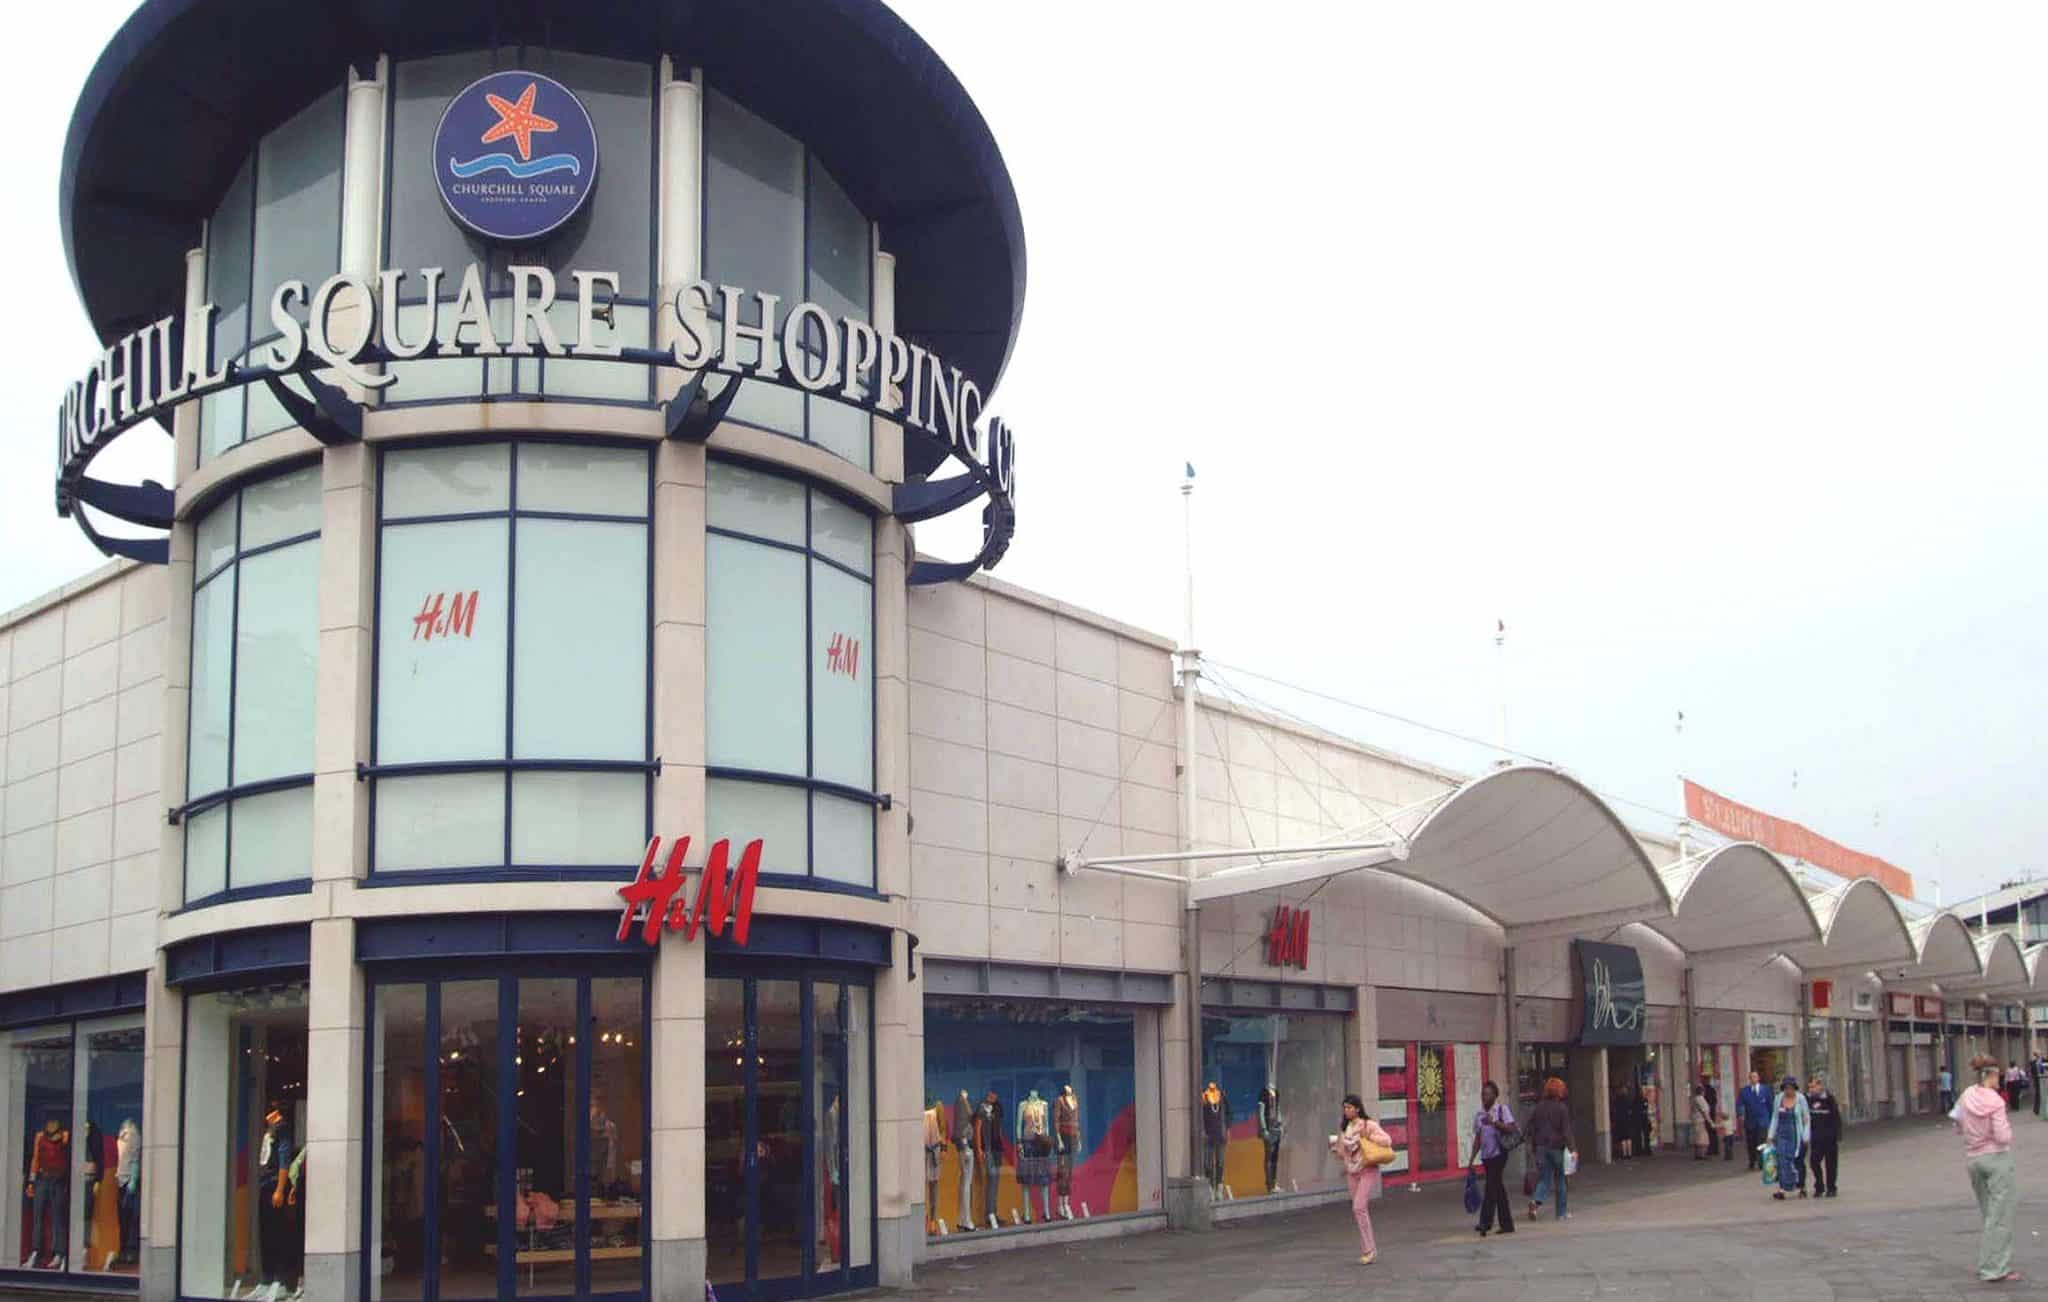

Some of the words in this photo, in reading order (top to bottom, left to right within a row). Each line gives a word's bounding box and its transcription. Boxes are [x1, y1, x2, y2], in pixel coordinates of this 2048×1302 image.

[452, 183, 524, 196] CHURCHILL
[529, 183, 577, 198] SQUARE
[266, 262, 624, 388] SQUARE
[671, 279, 983, 466] SHOPPING
[412, 589, 479, 641] H&M
[826, 631, 860, 681] H&M
[616, 835, 764, 947] H&M
